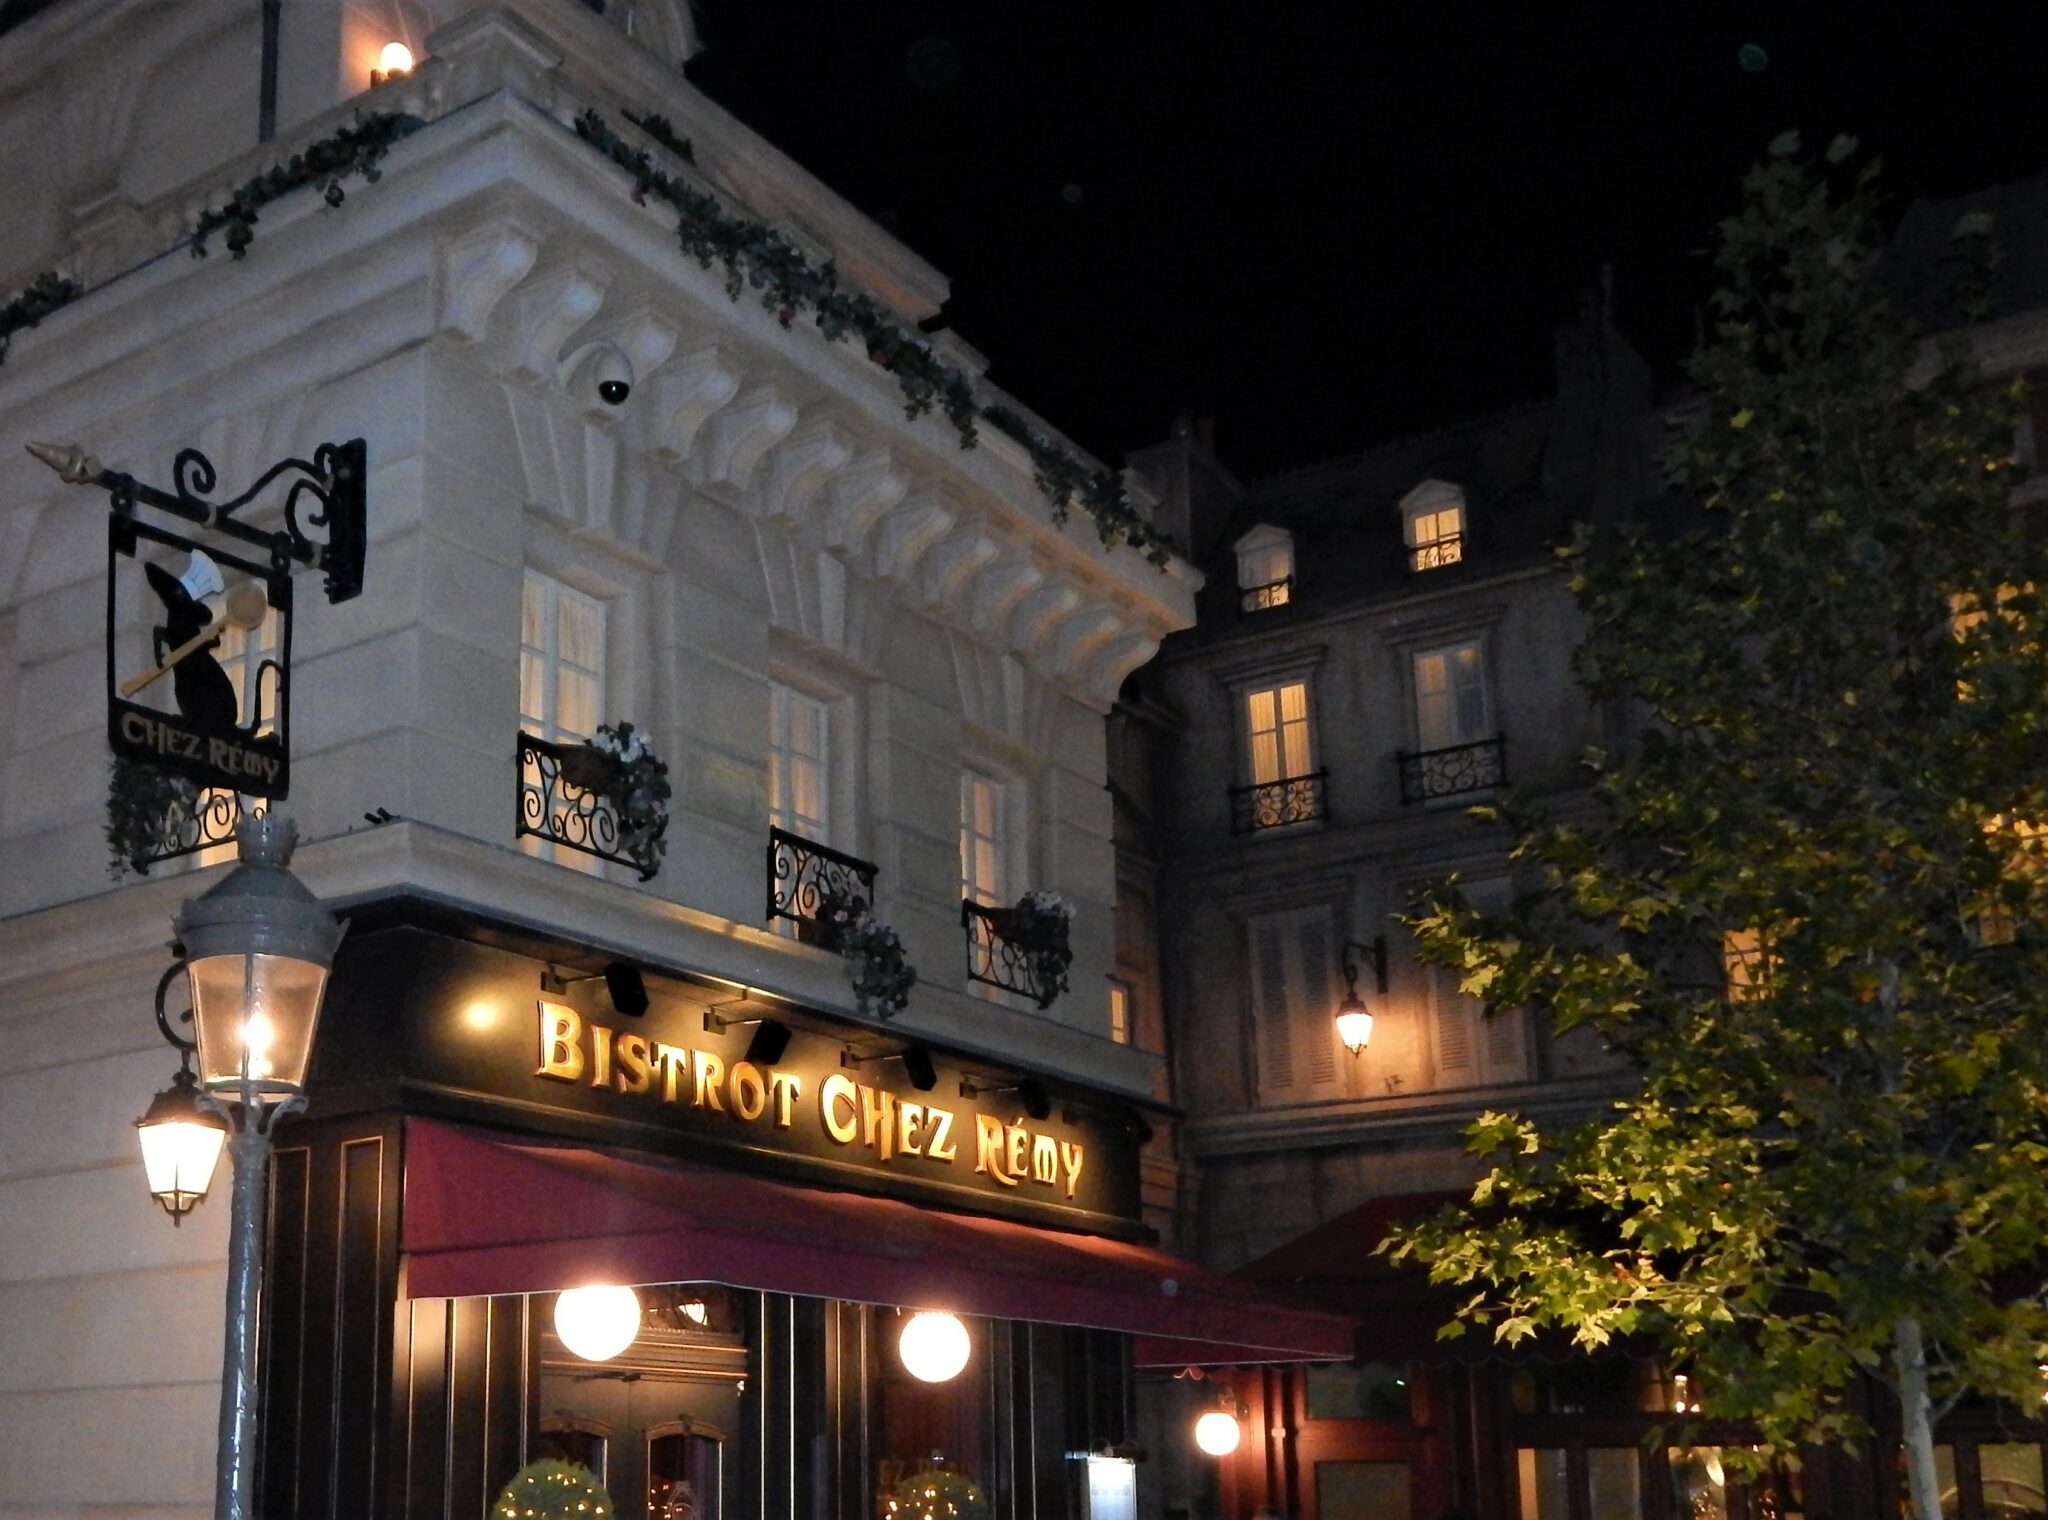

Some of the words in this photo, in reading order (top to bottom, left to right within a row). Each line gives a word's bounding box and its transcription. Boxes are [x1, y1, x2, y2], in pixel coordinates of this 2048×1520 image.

[121, 712, 203, 760] CHEZ
[534, 1000, 801, 1129] BISTROT
[817, 1072, 961, 1163] CHEZ
